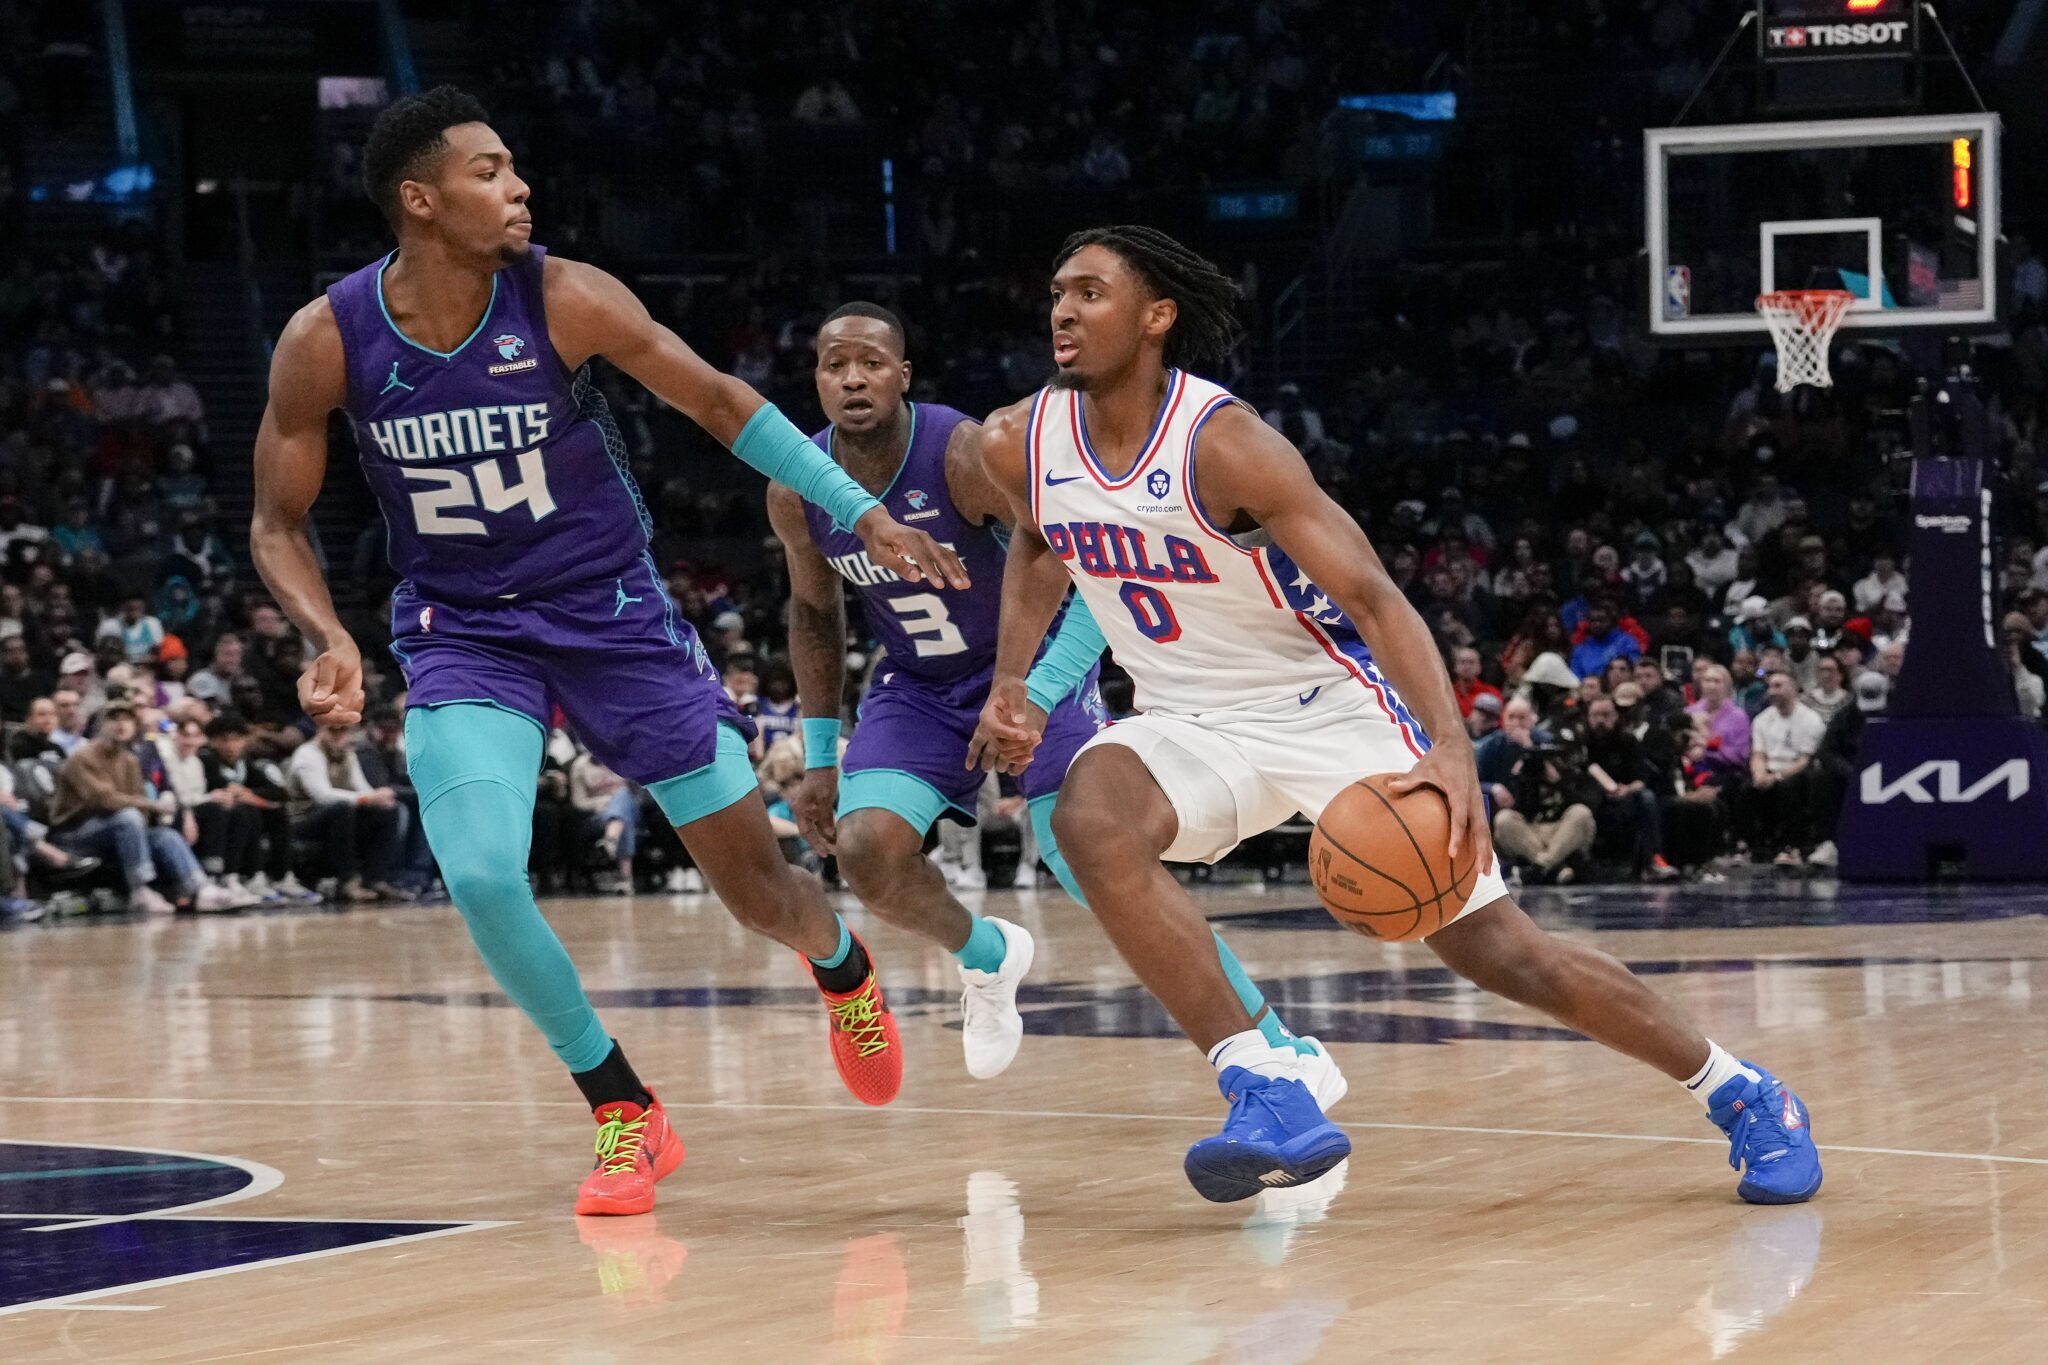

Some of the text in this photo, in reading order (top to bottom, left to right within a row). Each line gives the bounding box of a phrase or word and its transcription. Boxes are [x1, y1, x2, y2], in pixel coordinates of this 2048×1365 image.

[1807, 21, 1908, 46] TISSOT
[490, 359, 537, 374] FEASTABLES
[369, 402, 552, 461] HORNETS
[401, 448, 557, 536] 24
[1136, 505, 1183, 513] crypto.com
[1043, 522, 1220, 583] PHILA
[888, 593, 969, 657] 3
[1119, 581, 1182, 644] 0
